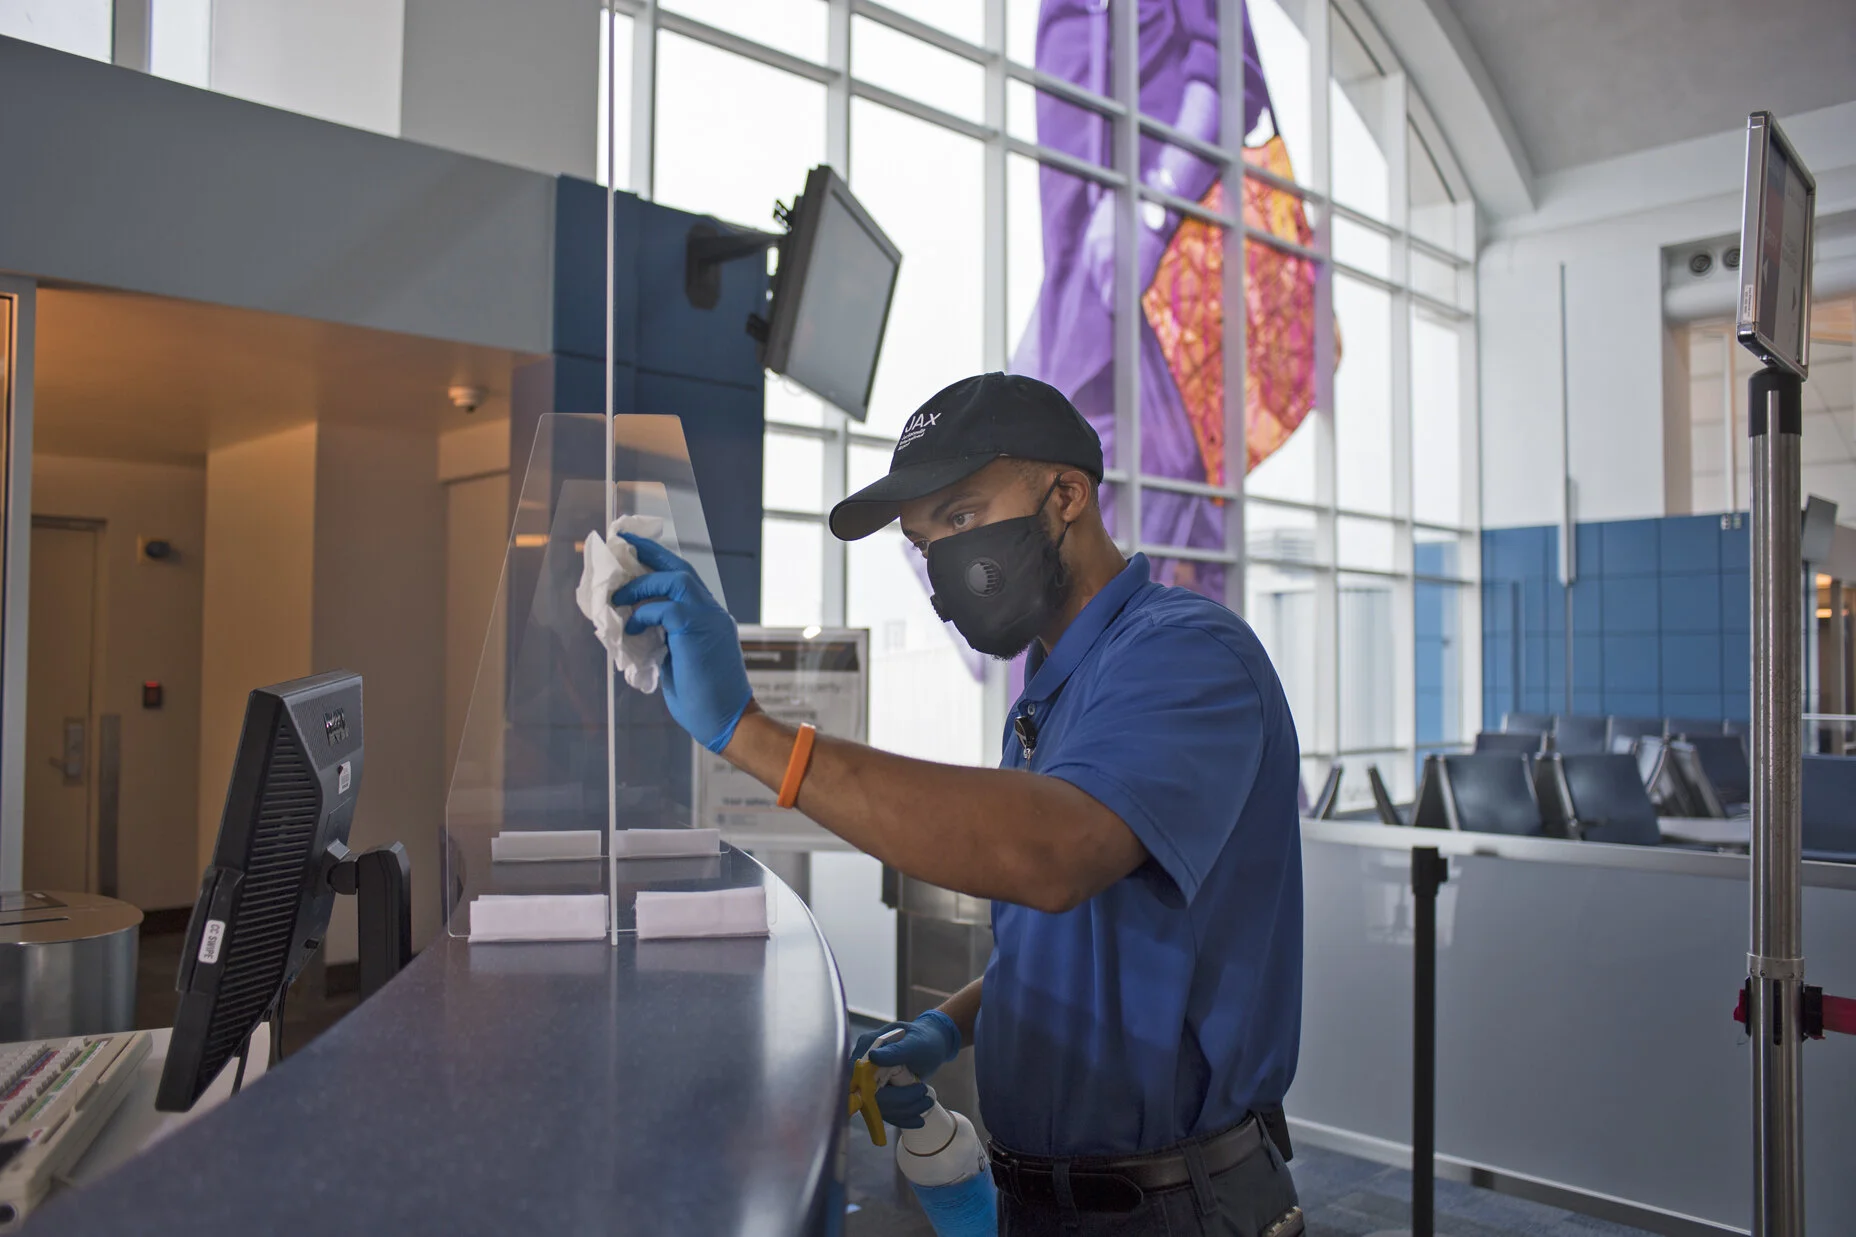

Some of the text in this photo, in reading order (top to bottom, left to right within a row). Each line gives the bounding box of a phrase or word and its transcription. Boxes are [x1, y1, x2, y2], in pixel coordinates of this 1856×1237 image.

[904, 412, 942, 433] JAX
[204, 924, 220, 959] CC SWIPE
